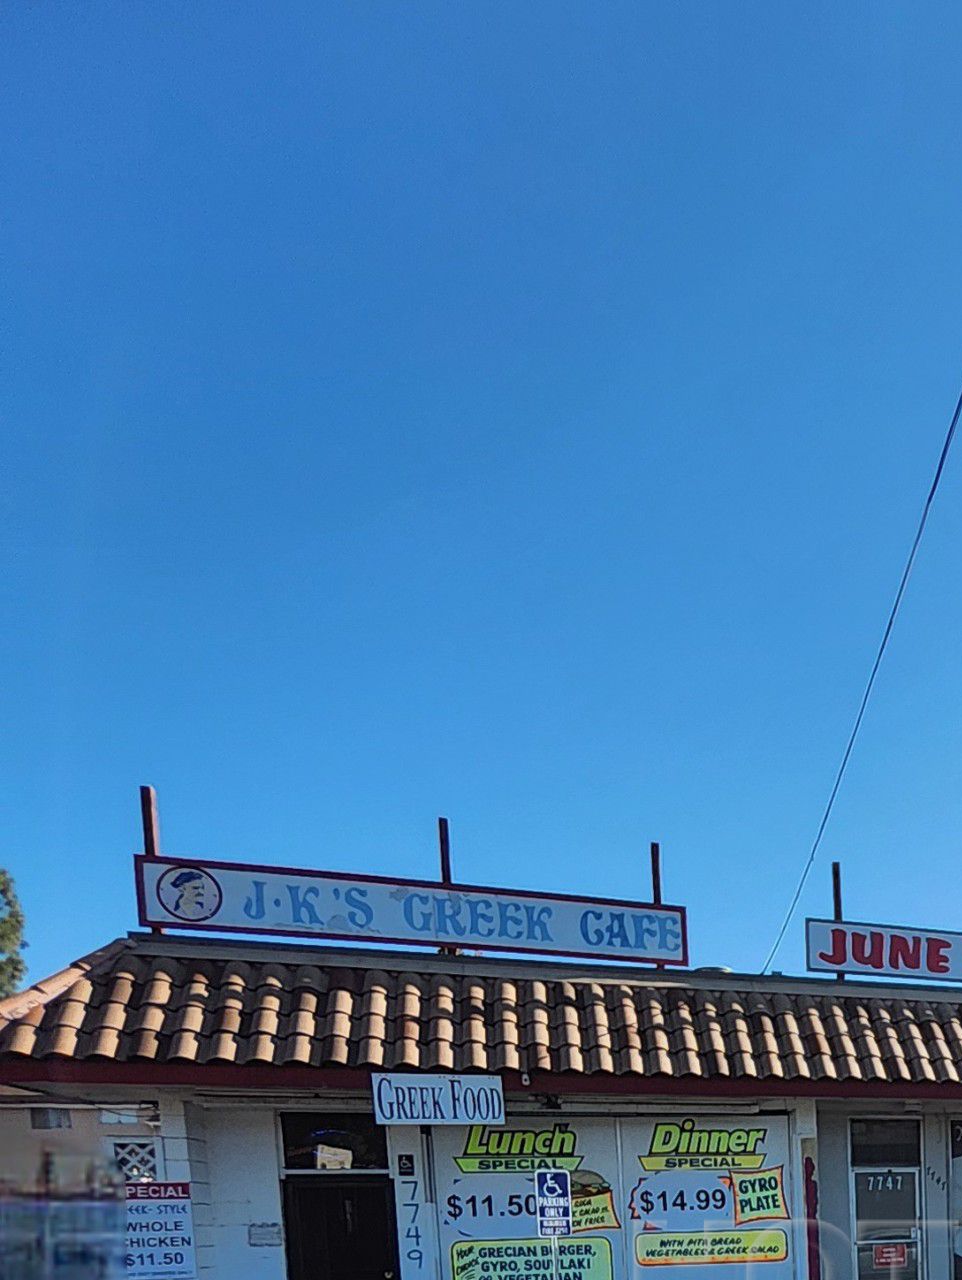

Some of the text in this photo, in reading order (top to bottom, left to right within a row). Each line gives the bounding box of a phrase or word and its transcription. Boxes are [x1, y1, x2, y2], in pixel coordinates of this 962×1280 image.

[403, 893, 553, 942] GREEK
[579, 909, 681, 952] CAFE
[818, 928, 952, 974] JUNE
[377, 1076, 501, 1121] GREEK FOOD
[463, 1123, 577, 1157] Lunch
[649, 1118, 768, 1156] Dinner
[477, 1158, 563, 1170] SPECIAL
[664, 1157, 742, 1168] SPECIAL
[126, 1186, 188, 1197] PECIAL
[738, 1176, 778, 1194] GYRO
[868, 1176, 902, 1191] 7747
[447, 1194, 537, 1220] $11.50
[640, 1188, 726, 1215] $14.99
[740, 1194, 781, 1213] PLATE
[126, 1237, 192, 1248] HICKEN
[659, 1239, 684, 1248] WITH
[711, 1237, 742, 1246] BREAD
[478, 1246, 537, 1259] GRECIAN
[481, 1261, 521, 1273] GYRO,
